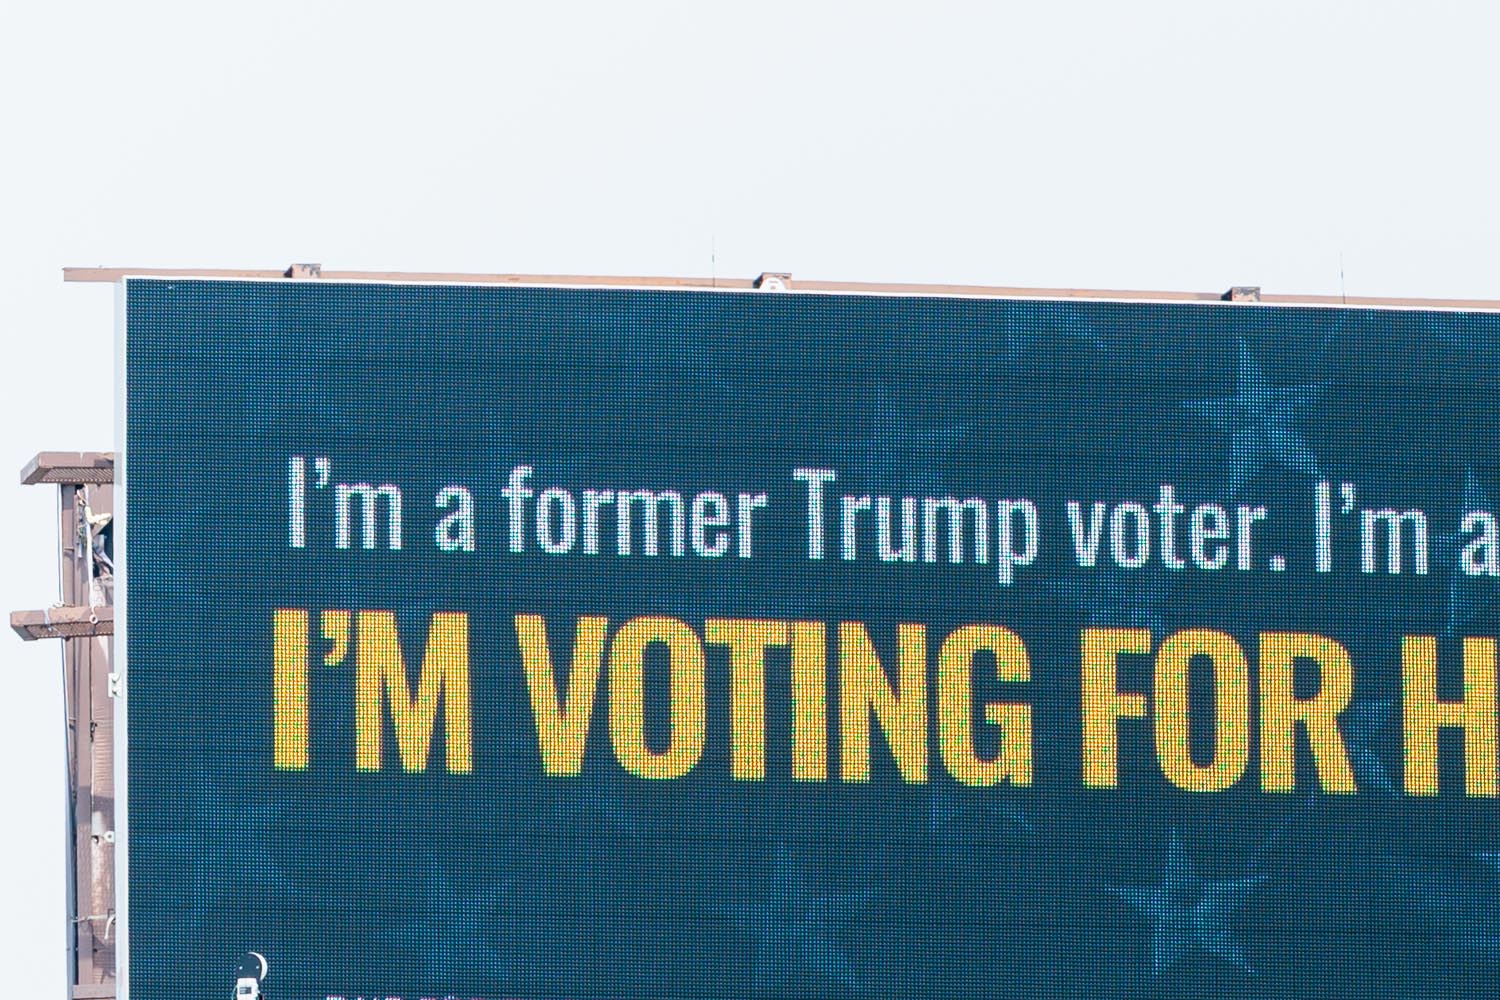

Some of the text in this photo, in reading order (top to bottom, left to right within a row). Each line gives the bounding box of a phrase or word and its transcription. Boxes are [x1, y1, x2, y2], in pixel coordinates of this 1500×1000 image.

[285, 456, 404, 550] I'm
[433, 485, 476, 553] a
[501, 466, 768, 559] former
[793, 468, 1042, 585] Trump
[1067, 484, 1287, 573] voter.
[1313, 481, 1430, 576] I'm
[1460, 509, 1500, 577] a
[273, 609, 473, 774] I'M
[514, 613, 1034, 788] VOTING
[1081, 628, 1357, 795] FOR
